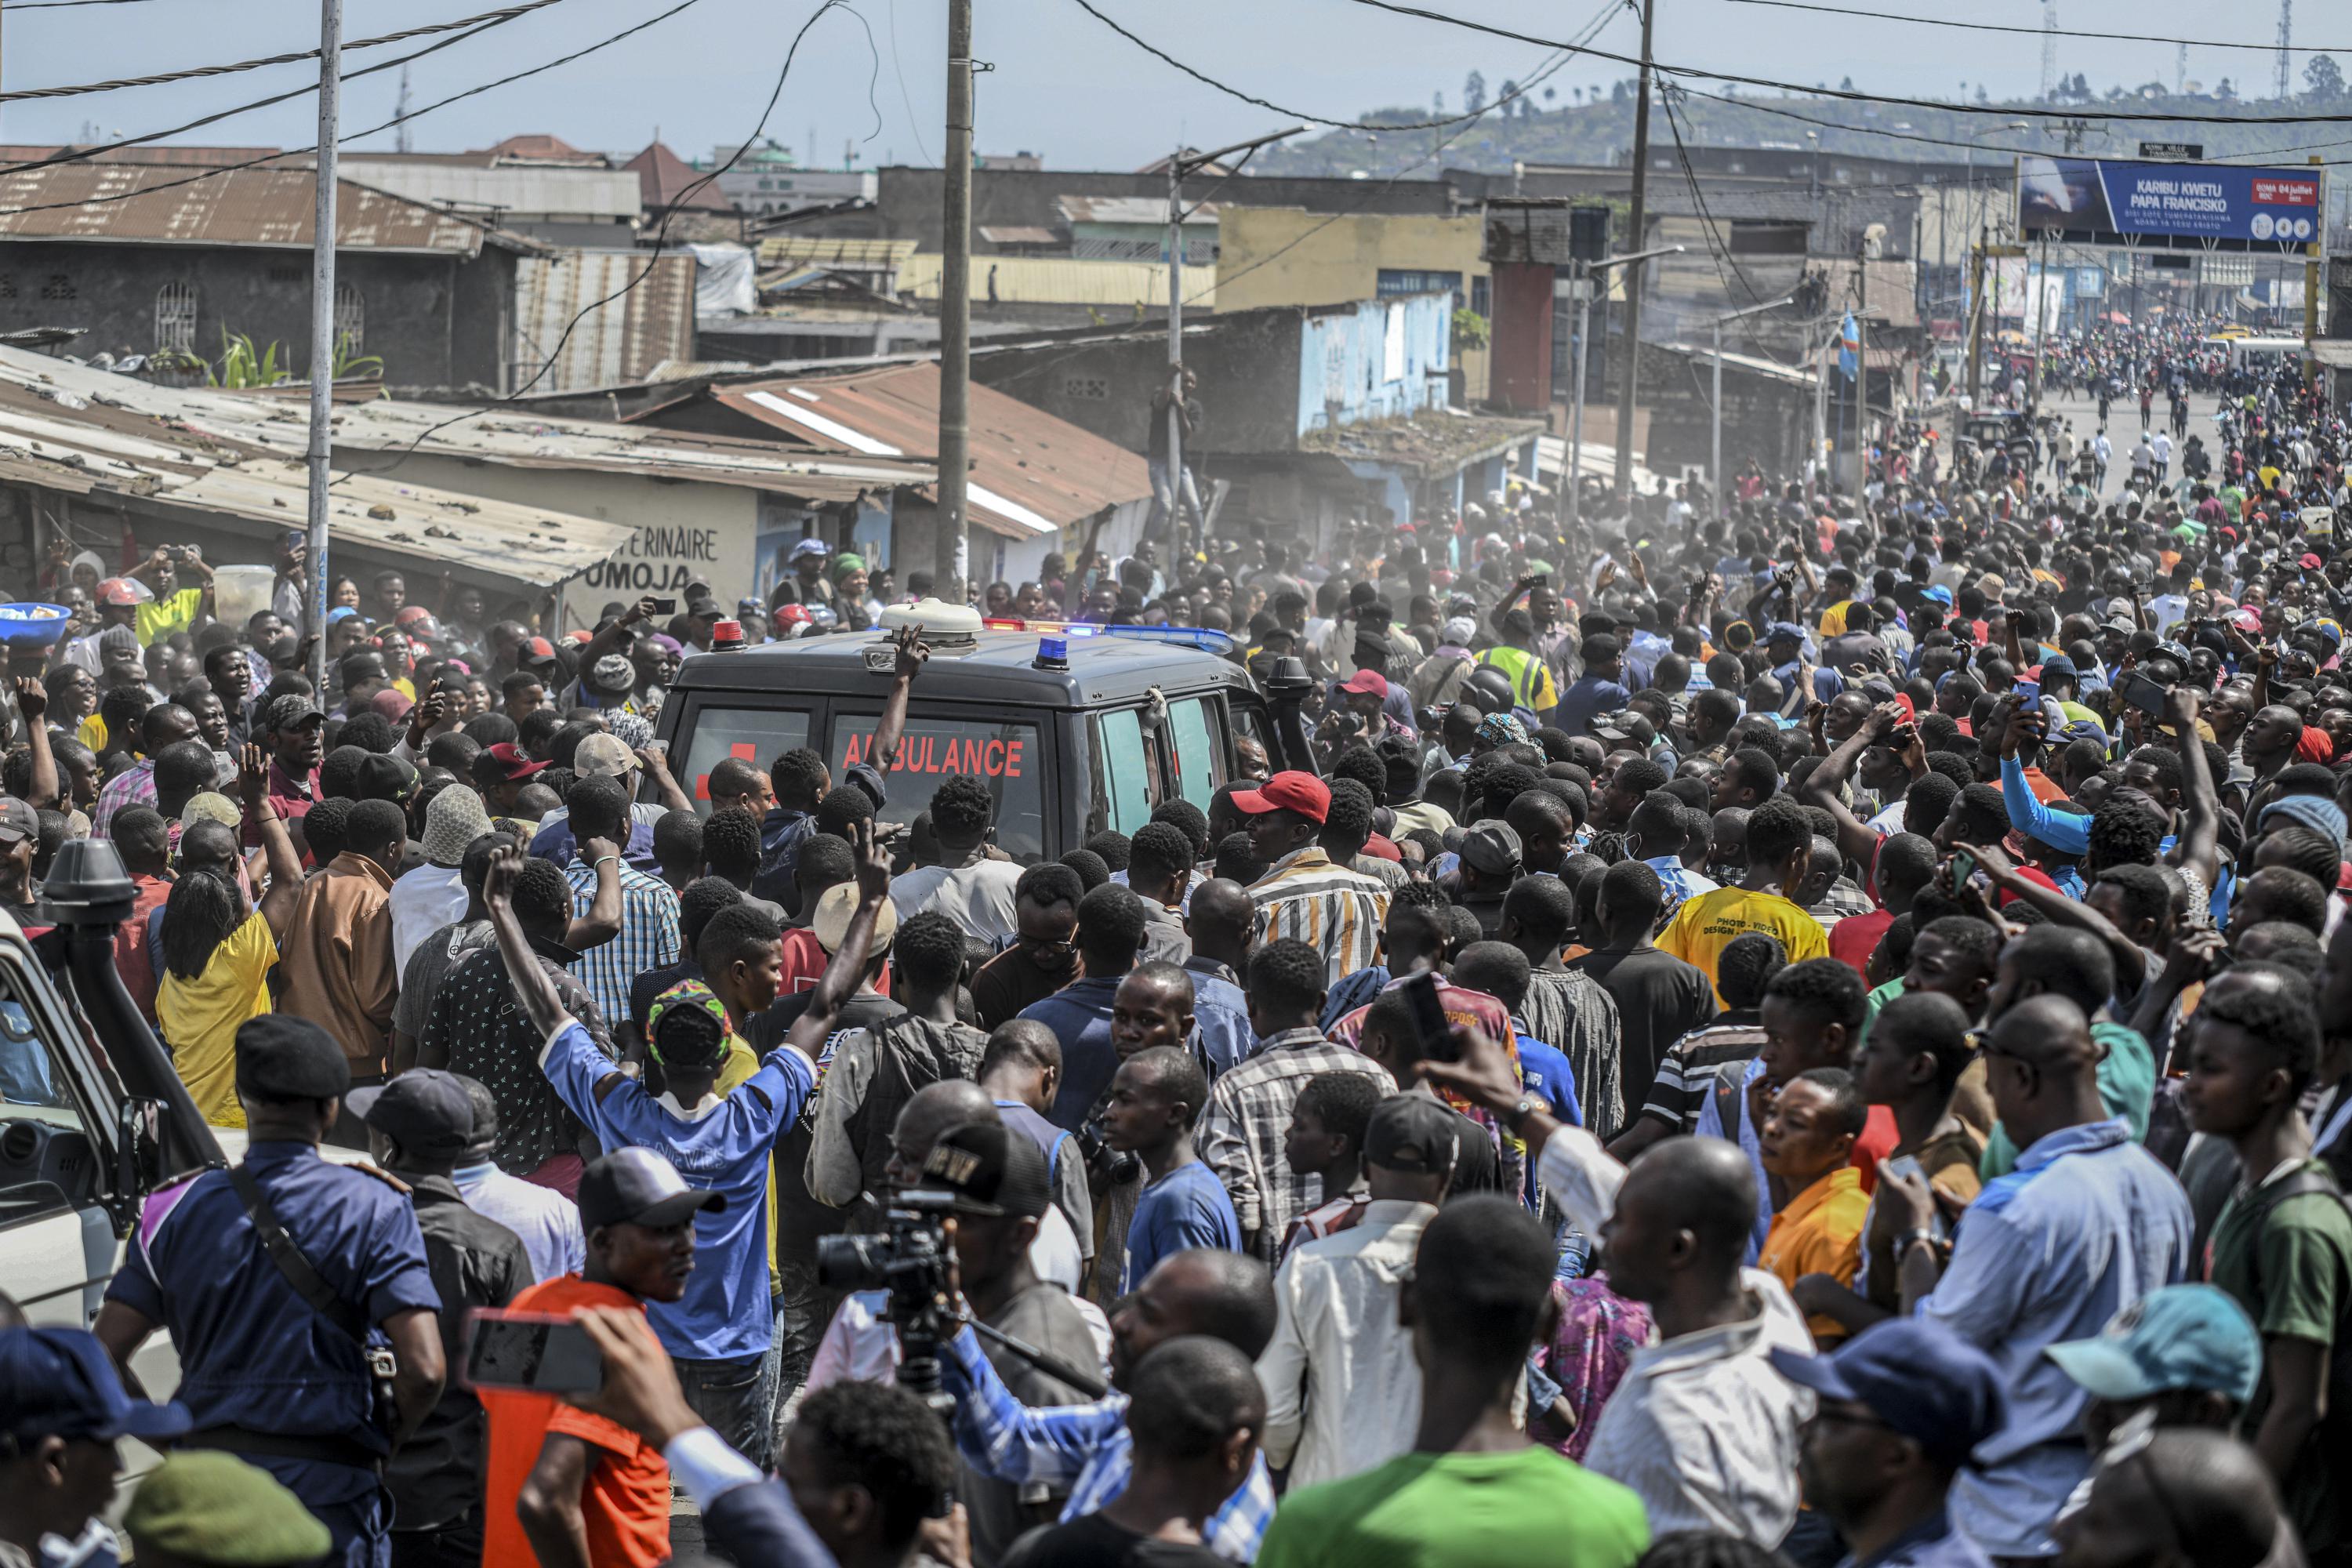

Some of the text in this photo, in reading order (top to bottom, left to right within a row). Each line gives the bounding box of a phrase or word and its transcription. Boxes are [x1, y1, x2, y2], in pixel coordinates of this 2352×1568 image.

[2137, 179, 2222, 198] KARIBU KWETU
[2131, 194, 2227, 212] PAPA FRANCISKO
[586, 562, 690, 591] UMOJA
[842, 733, 1023, 778] ABULANCE
[1703, 925, 1735, 935] DESIGN
[1716, 917, 1746, 928] PHOTO
[1753, 921, 1779, 935] VIDEO
